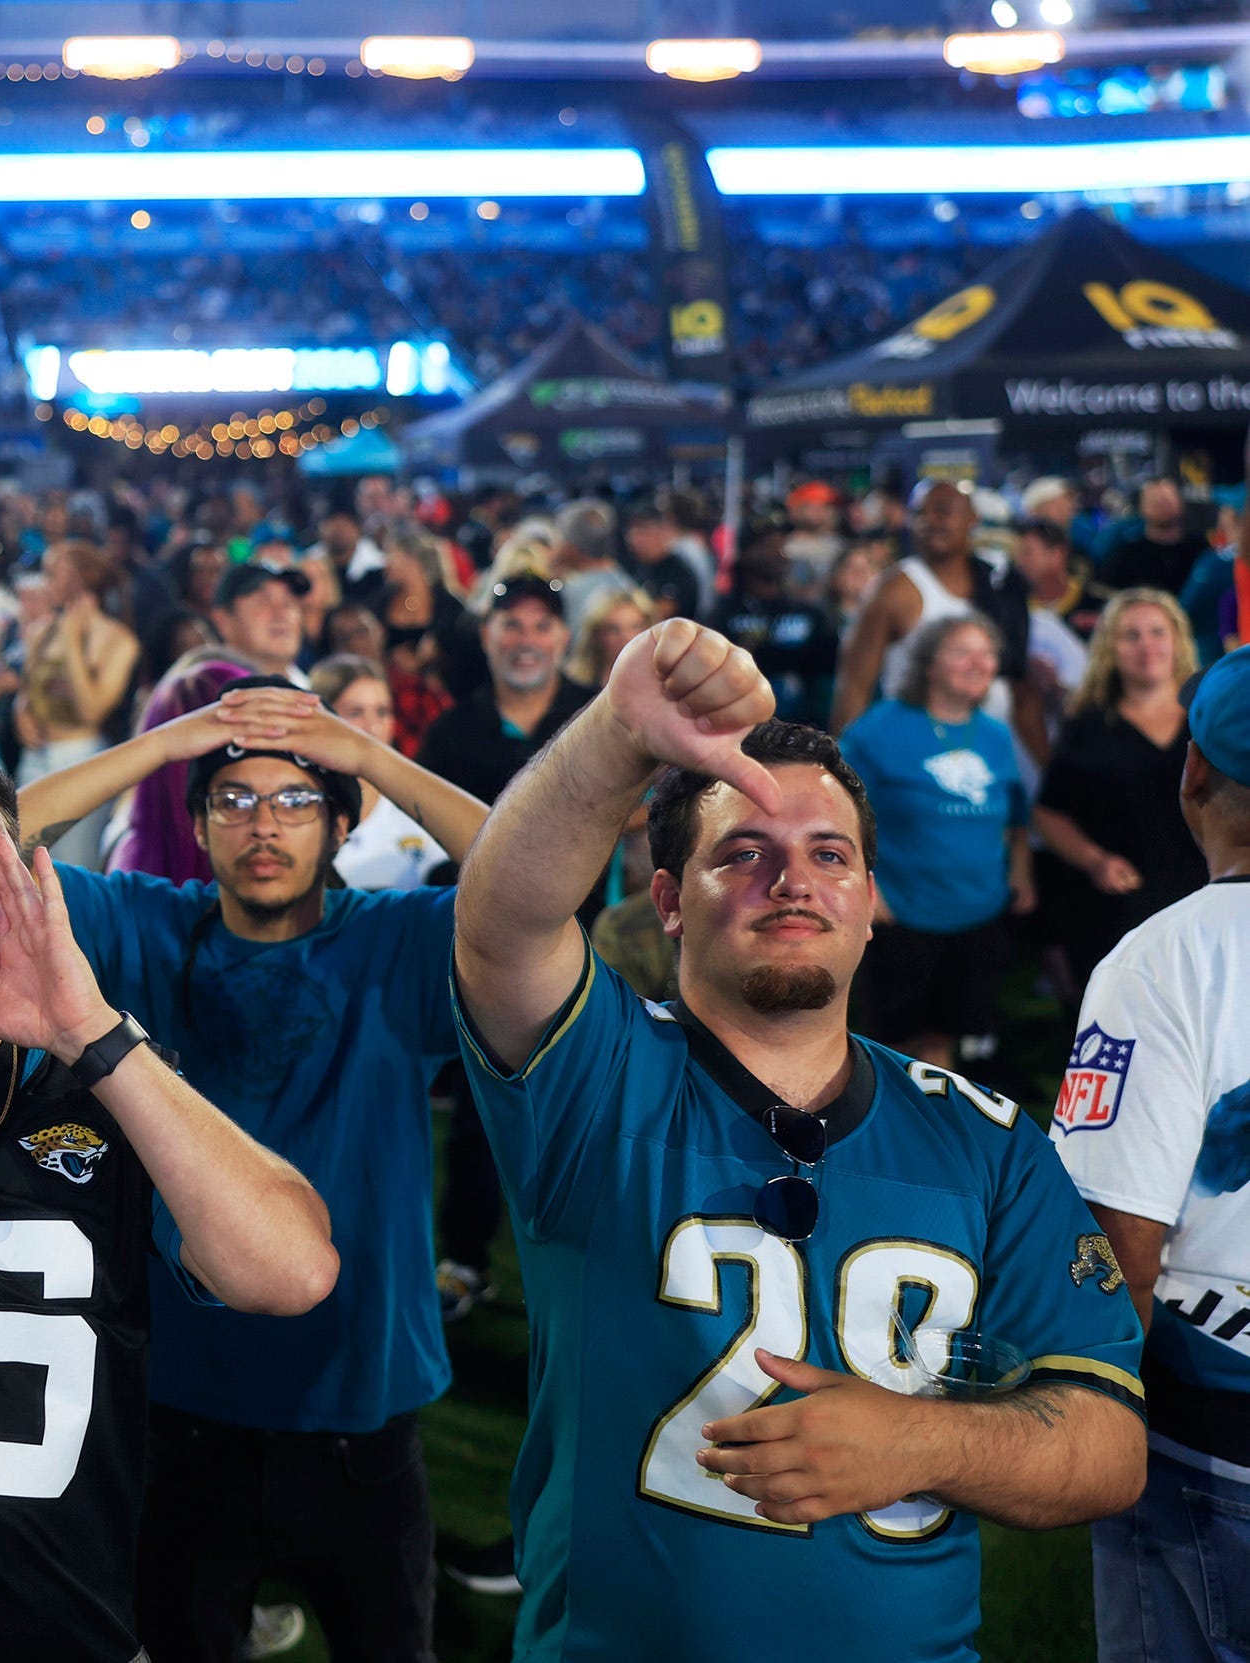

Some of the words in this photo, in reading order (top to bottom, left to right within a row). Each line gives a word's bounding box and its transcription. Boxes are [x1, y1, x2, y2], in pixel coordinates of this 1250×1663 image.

[1083, 279, 1218, 333] IQ
[1005, 377, 1164, 415] Welcome
[1167, 379, 1205, 412] to
[1054, 1072, 1109, 1123] NFL
